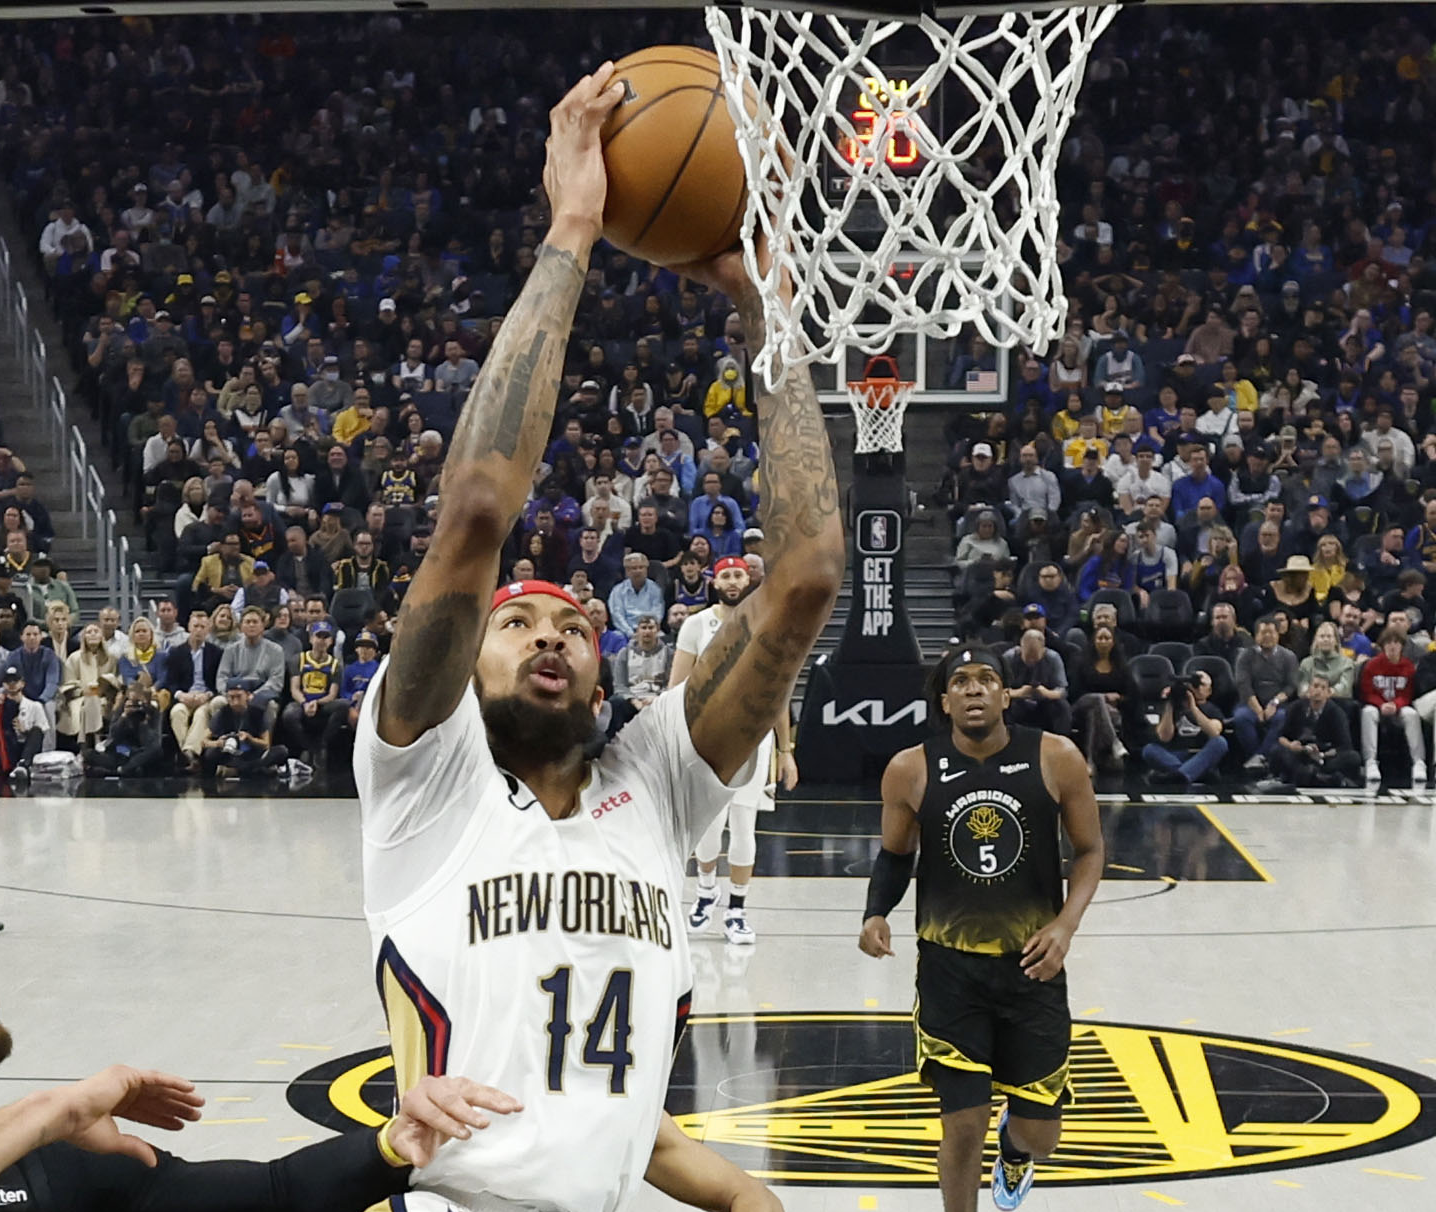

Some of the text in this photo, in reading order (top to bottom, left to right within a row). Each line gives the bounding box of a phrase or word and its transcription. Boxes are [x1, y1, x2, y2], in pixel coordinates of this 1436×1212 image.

[849, 110, 918, 164] 20
[863, 557, 894, 582] GET
[862, 584, 894, 609] THE
[862, 611, 894, 636] APP
[823, 700, 927, 726] KIA
[591, 789, 633, 820] otta
[945, 790, 1022, 819] WARRIORS
[979, 844, 997, 873] 5
[467, 871, 554, 947] NEW
[537, 964, 635, 1098] 14
